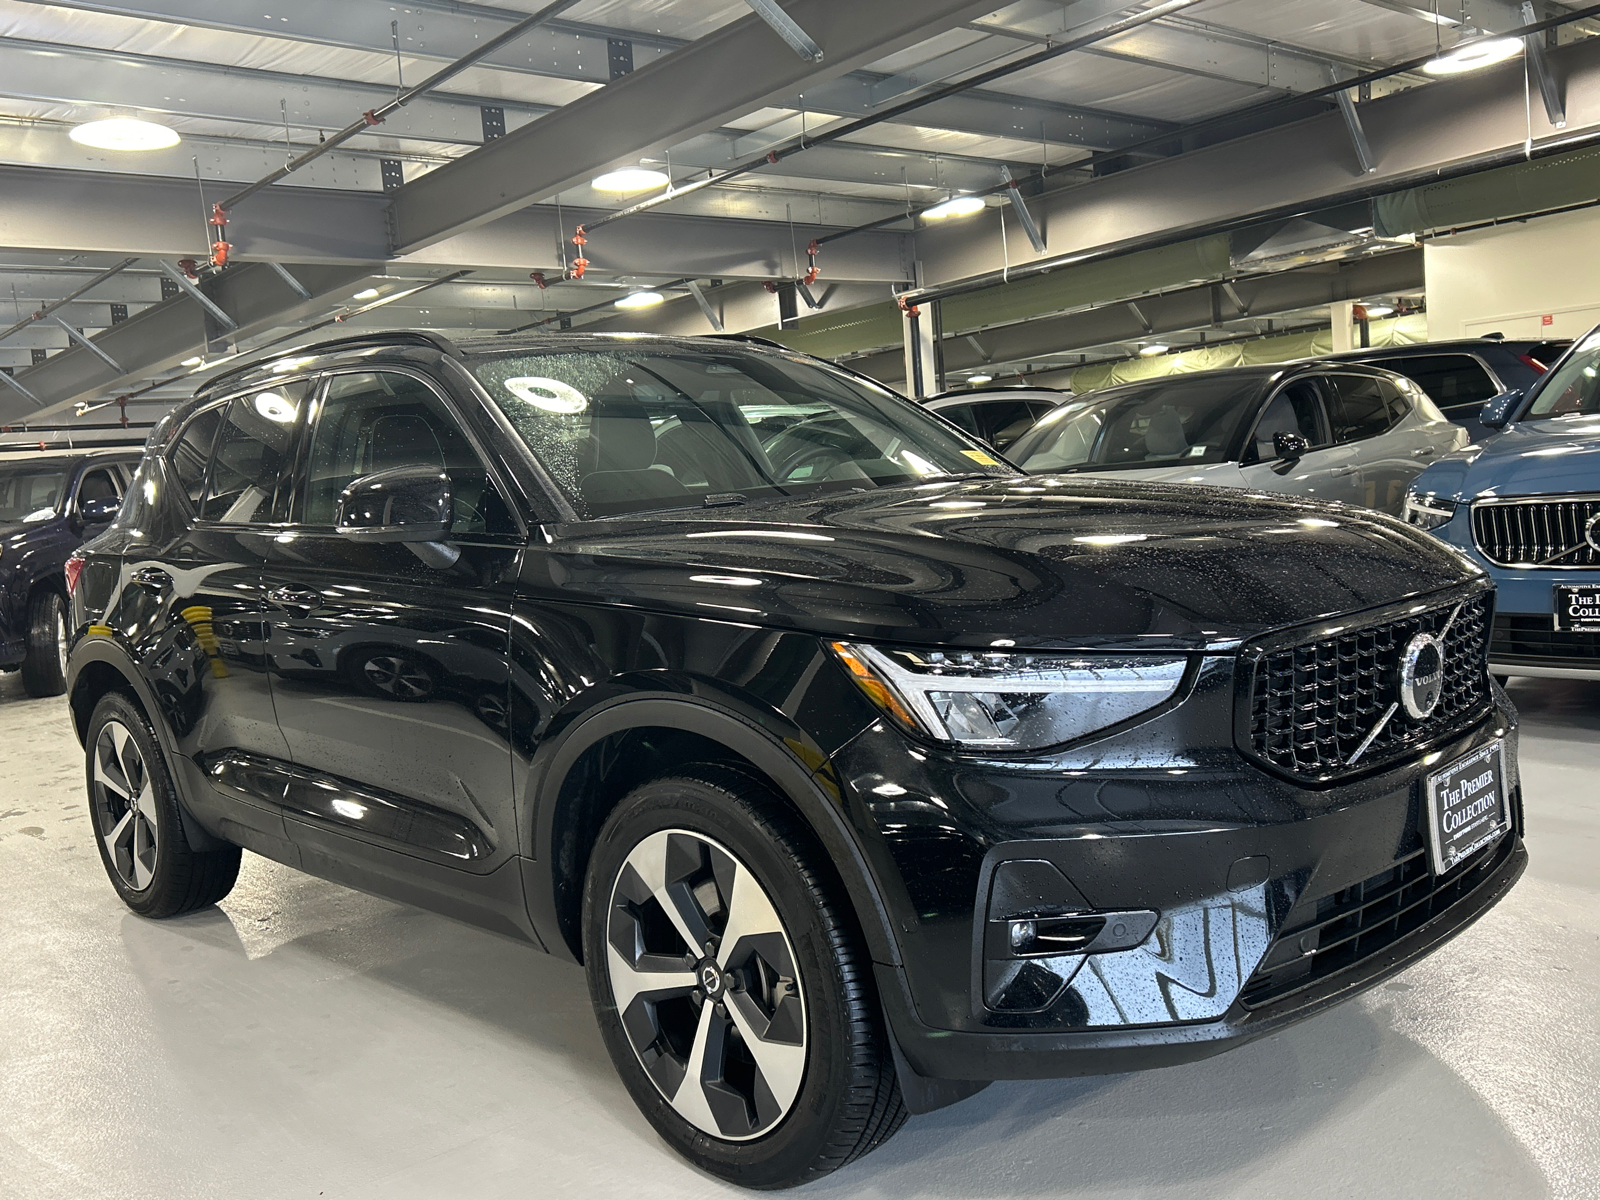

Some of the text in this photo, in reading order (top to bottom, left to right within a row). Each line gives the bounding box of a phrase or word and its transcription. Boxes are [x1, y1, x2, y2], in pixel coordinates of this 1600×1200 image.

[1568, 594, 1593, 604] THE
[1441, 769, 1494, 810] THE PREMIER
[1442, 790, 1496, 833] COLLECTION
